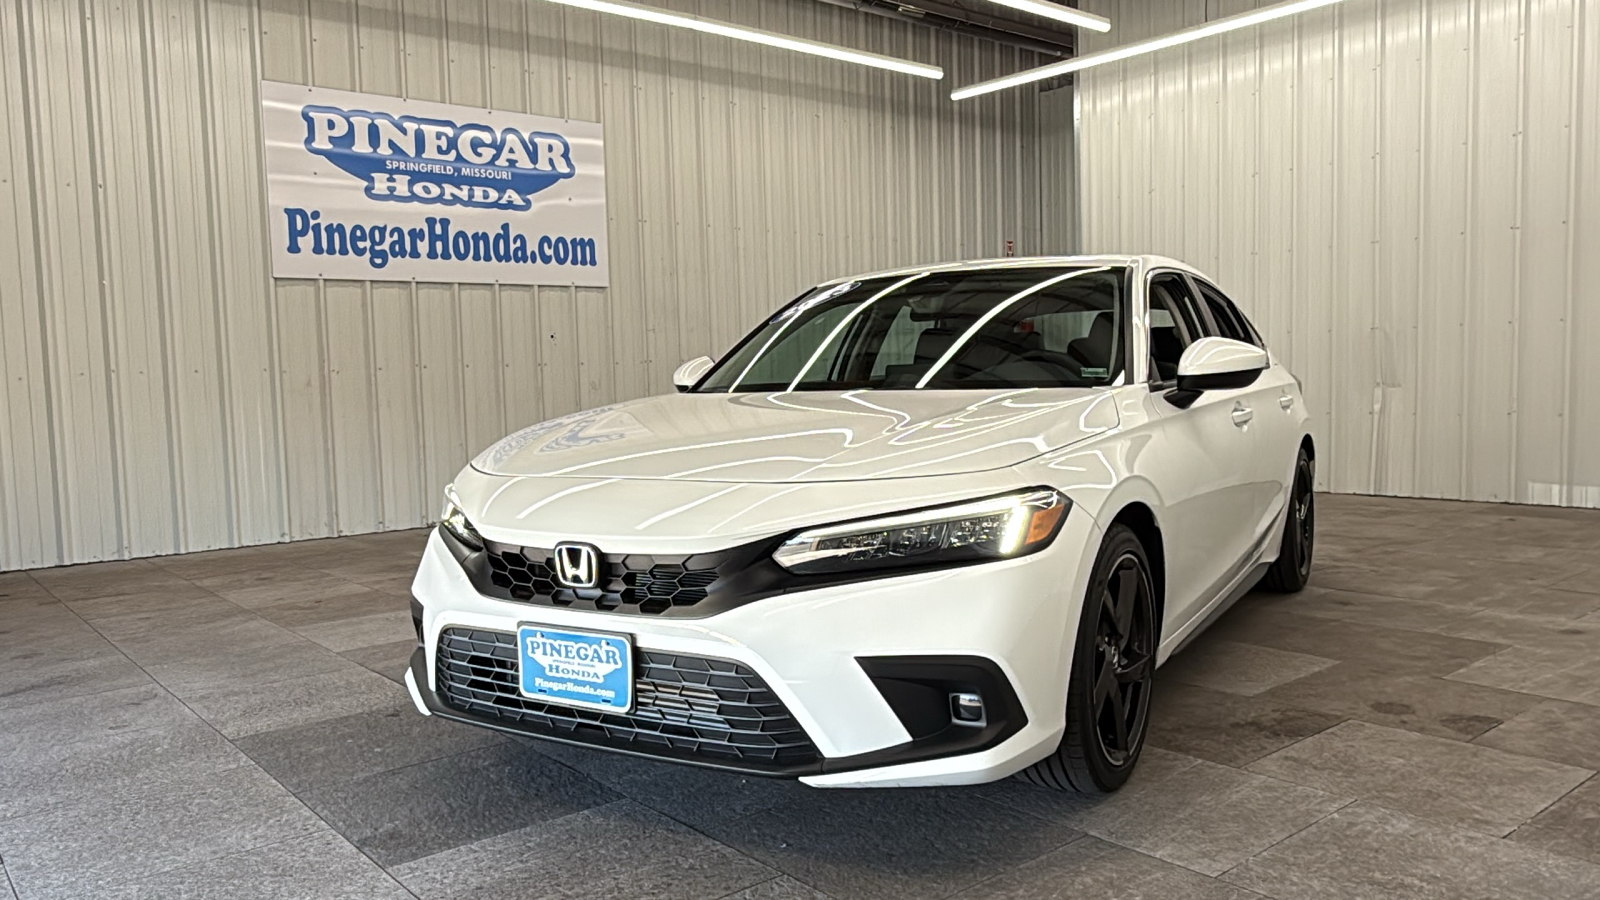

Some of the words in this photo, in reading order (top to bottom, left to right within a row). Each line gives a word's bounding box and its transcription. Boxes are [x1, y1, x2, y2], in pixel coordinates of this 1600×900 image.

[307, 110, 571, 173] PINEGAR
[385, 159, 458, 177] SPRINGFIELD,
[460, 166, 512, 180] MISSOURI
[370, 172, 527, 205] HONDA
[284, 207, 597, 269] PinegarHonda.com
[529, 640, 619, 665] PINEGAR
[548, 663, 601, 680] HONDA
[534, 677, 616, 698] PinegarHonda.com
